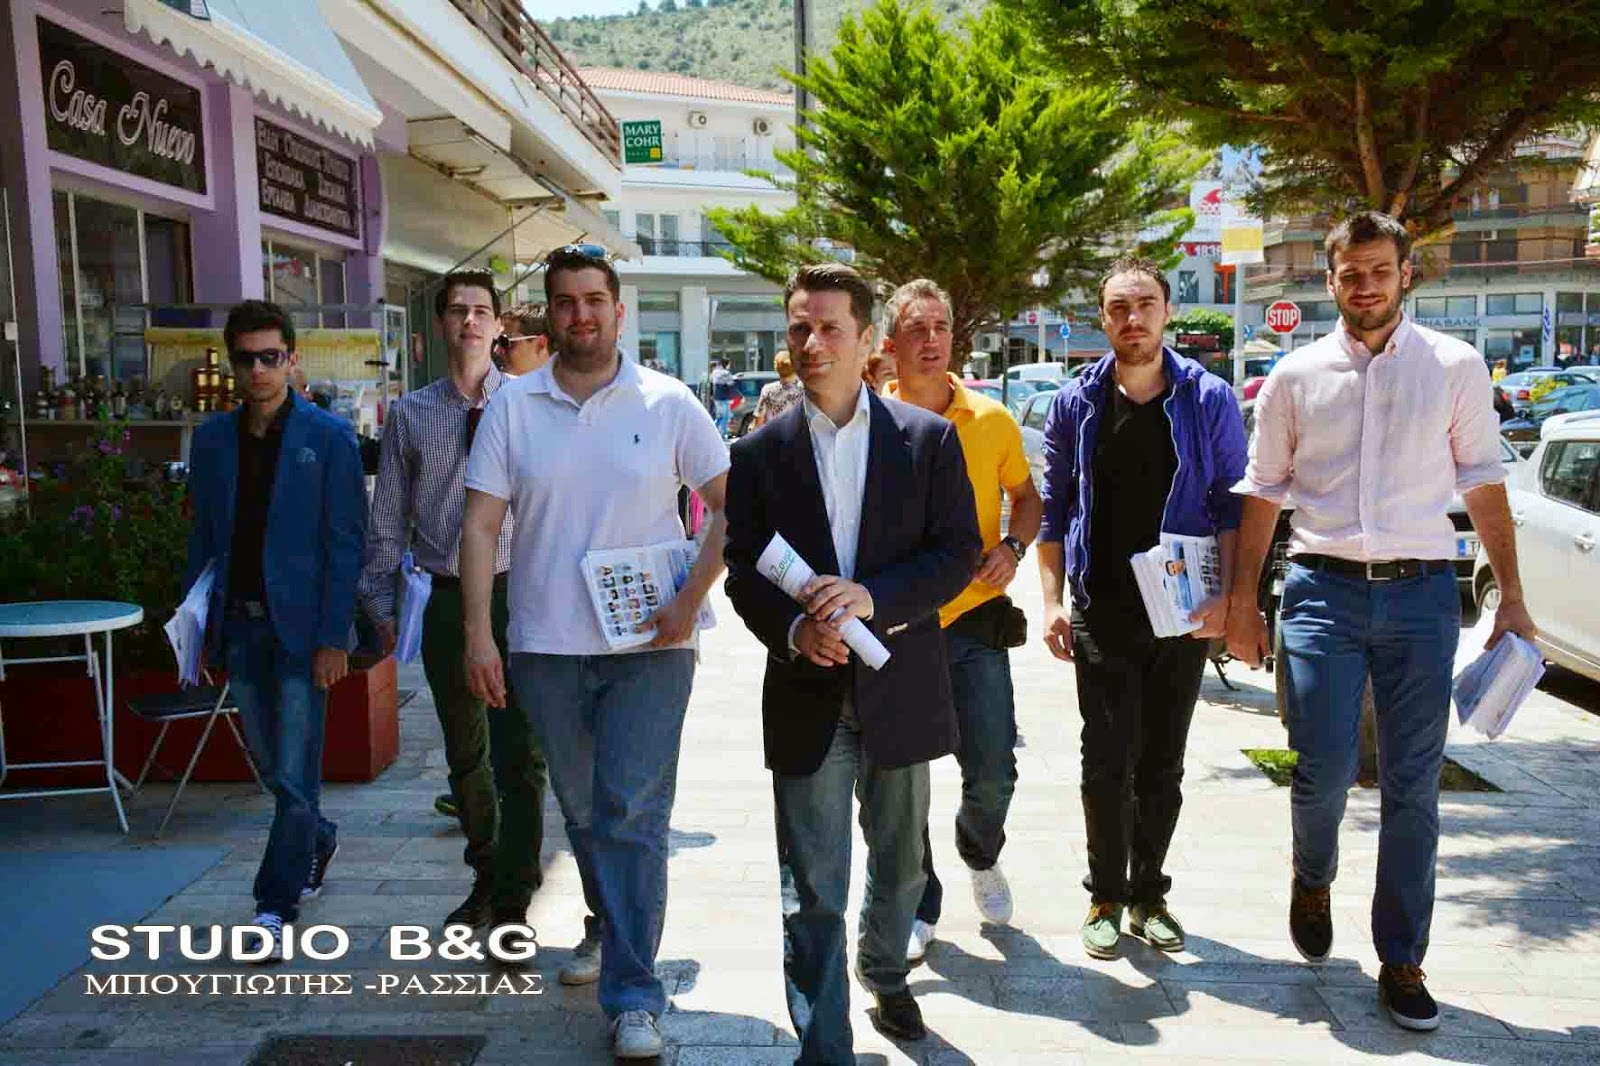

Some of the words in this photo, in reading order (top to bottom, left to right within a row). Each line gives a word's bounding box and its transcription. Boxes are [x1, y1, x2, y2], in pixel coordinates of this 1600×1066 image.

[50, 59, 108, 136] Casa
[625, 124, 659, 136] MARY
[626, 136, 661, 148] COHR
[1268, 309, 1299, 326] STOP
